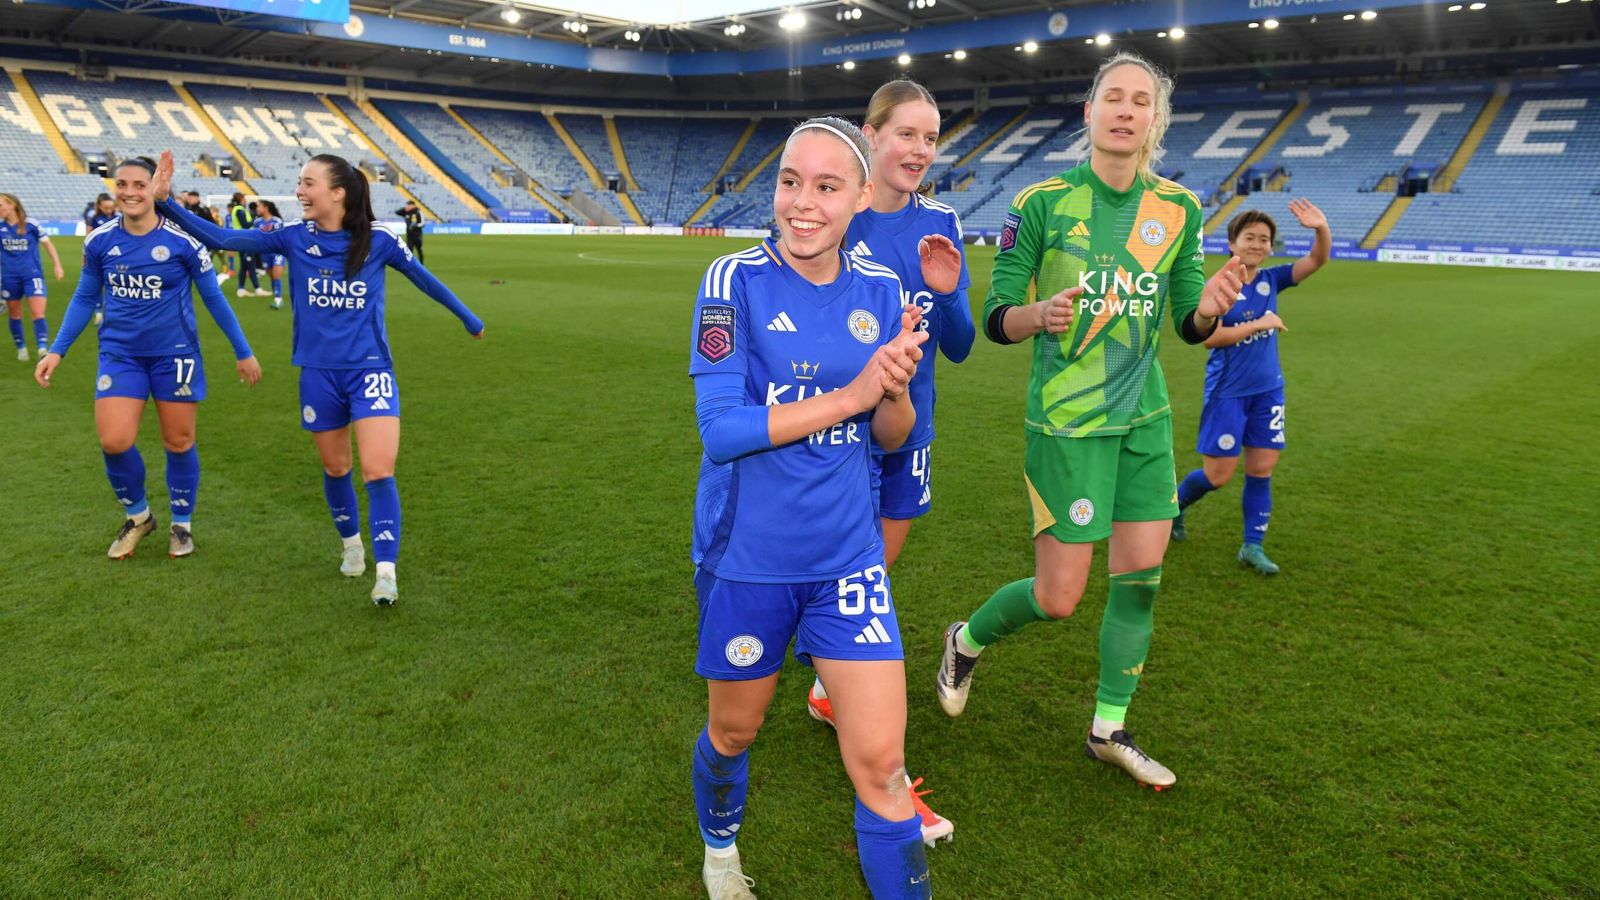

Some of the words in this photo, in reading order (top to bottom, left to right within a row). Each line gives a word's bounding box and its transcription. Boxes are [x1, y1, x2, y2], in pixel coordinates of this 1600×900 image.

[822, 46, 842, 56] KING
[843, 42, 871, 53] POWER
[872, 38, 905, 50] STADIUM
[108, 272, 163, 289] KING
[307, 278, 367, 297] KING
[1079, 271, 1159, 296] KING
[112, 286, 161, 299] POWER
[309, 294, 366, 309] POWER
[1079, 299, 1154, 317] POWER
[174, 358, 195, 384] 17
[364, 372, 393, 398] 20
[838, 564, 889, 615] 53
